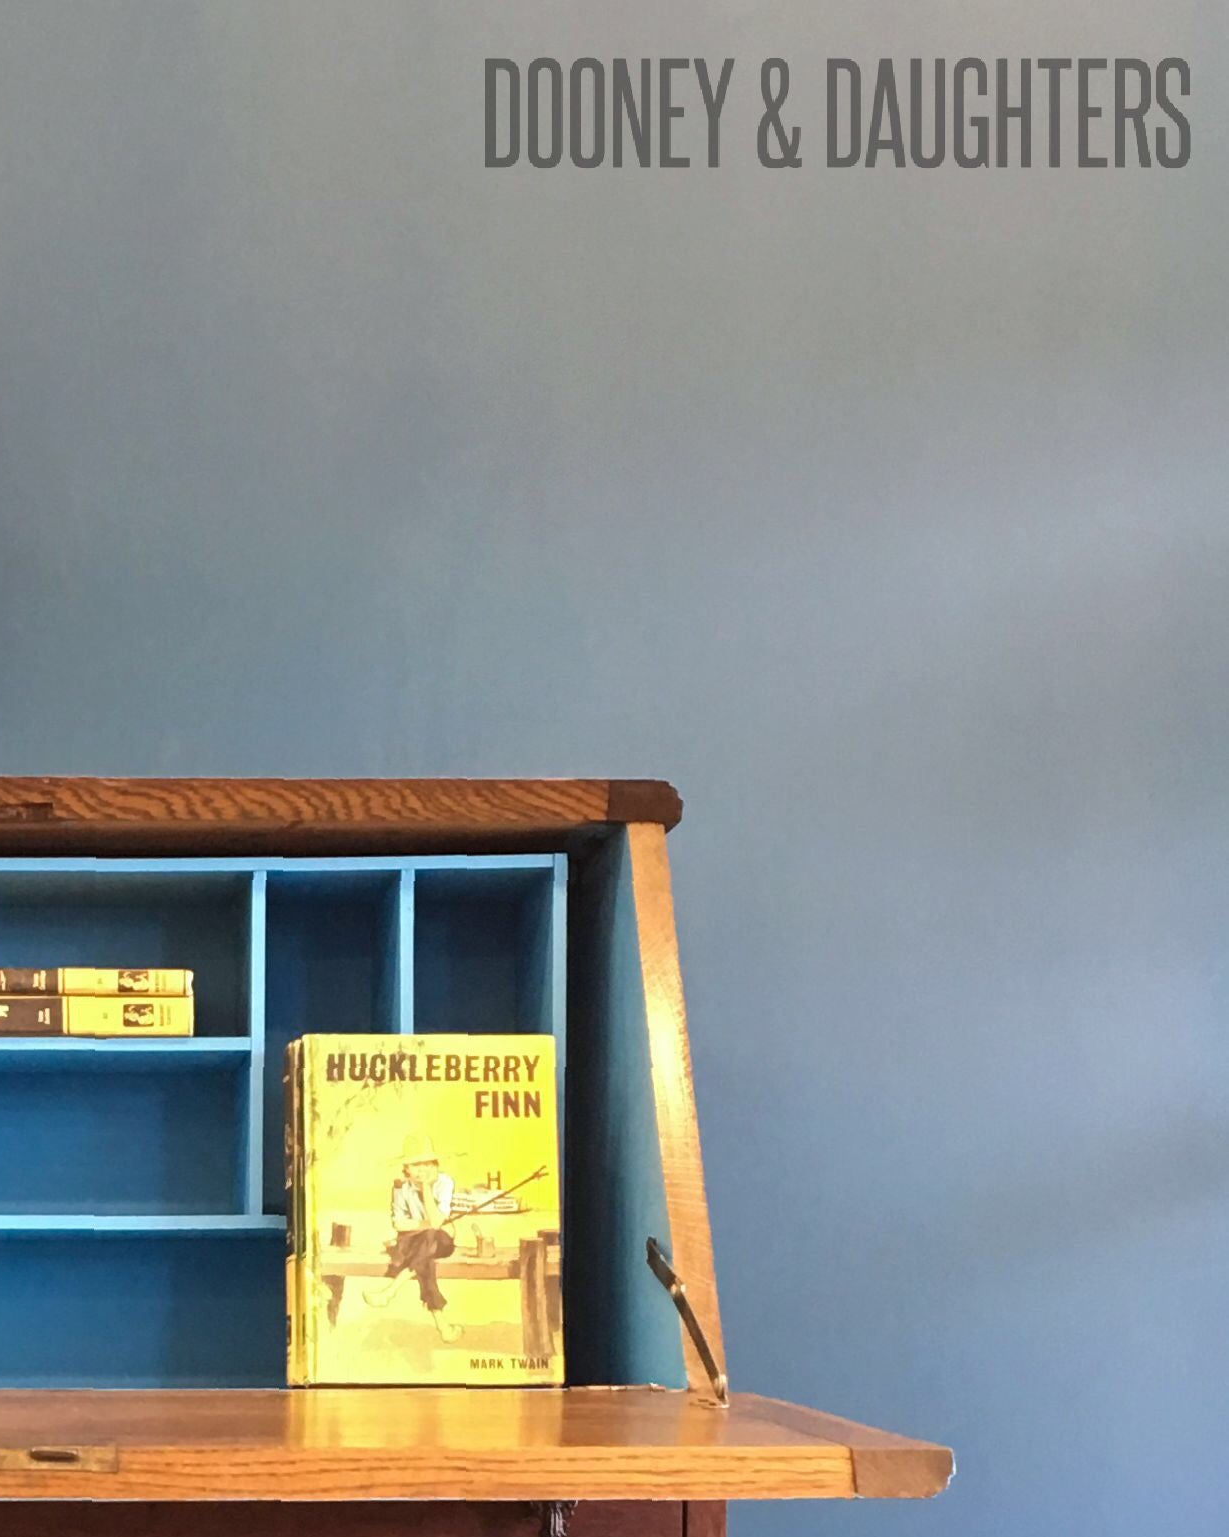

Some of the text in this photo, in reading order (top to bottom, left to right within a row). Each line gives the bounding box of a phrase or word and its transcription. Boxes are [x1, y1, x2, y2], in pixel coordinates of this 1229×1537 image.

[326, 1053, 541, 1083] HUCKLEBERRY
[475, 1090, 542, 1119] FINN
[469, 1358, 549, 1369] MARK TWAIN
